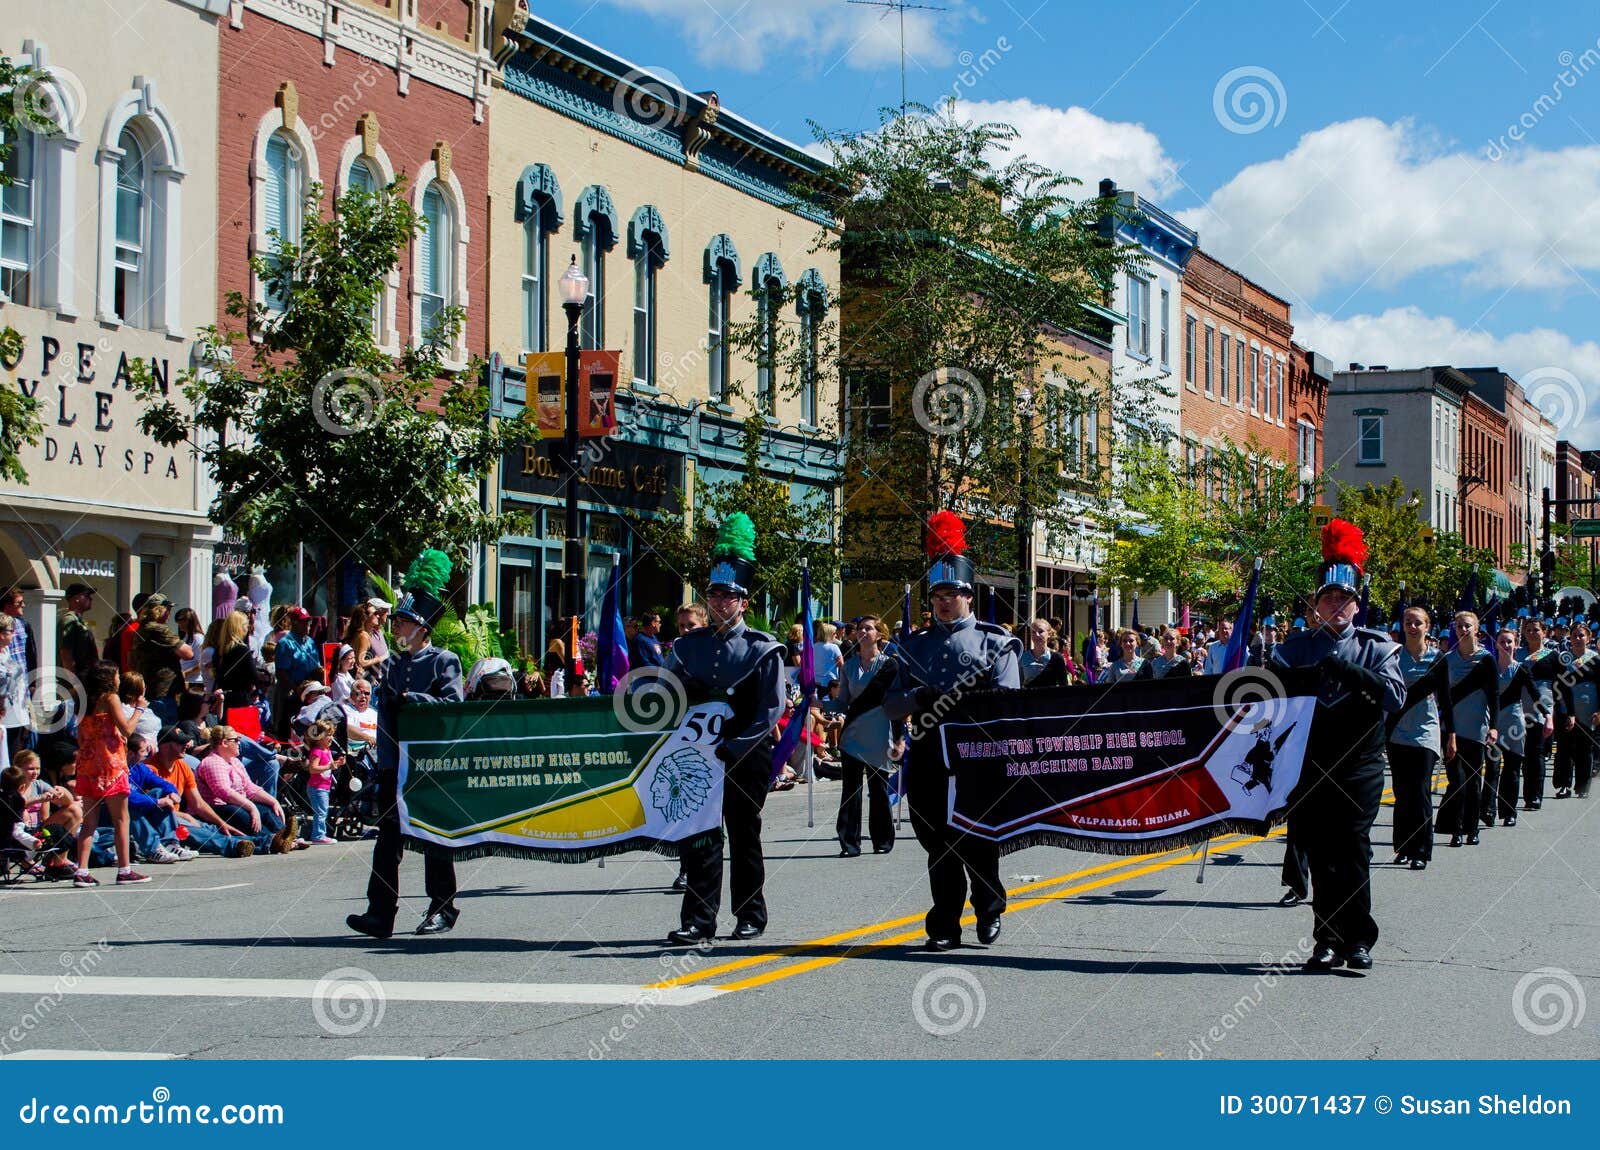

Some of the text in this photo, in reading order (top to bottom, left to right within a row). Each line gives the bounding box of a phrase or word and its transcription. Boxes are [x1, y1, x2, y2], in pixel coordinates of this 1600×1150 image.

[45, 437, 105, 468] DAY
[125, 449, 178, 479] SPA
[59, 557, 115, 577] MASSAGE
[680, 712, 725, 746] 59
[956, 730, 1186, 758] WASHINGTON TOWNSHIP HIGH SCHOOL
[414, 751, 632, 772] MORGAN TOWNSHIP HIGH SCHOOL
[1006, 756, 1134, 776] MARCHING BAND
[467, 772, 582, 788] MARCHING BAND
[1071, 808, 1190, 827] VALPARAISO, INDIANA
[583, 825, 619, 838] INDIANA
